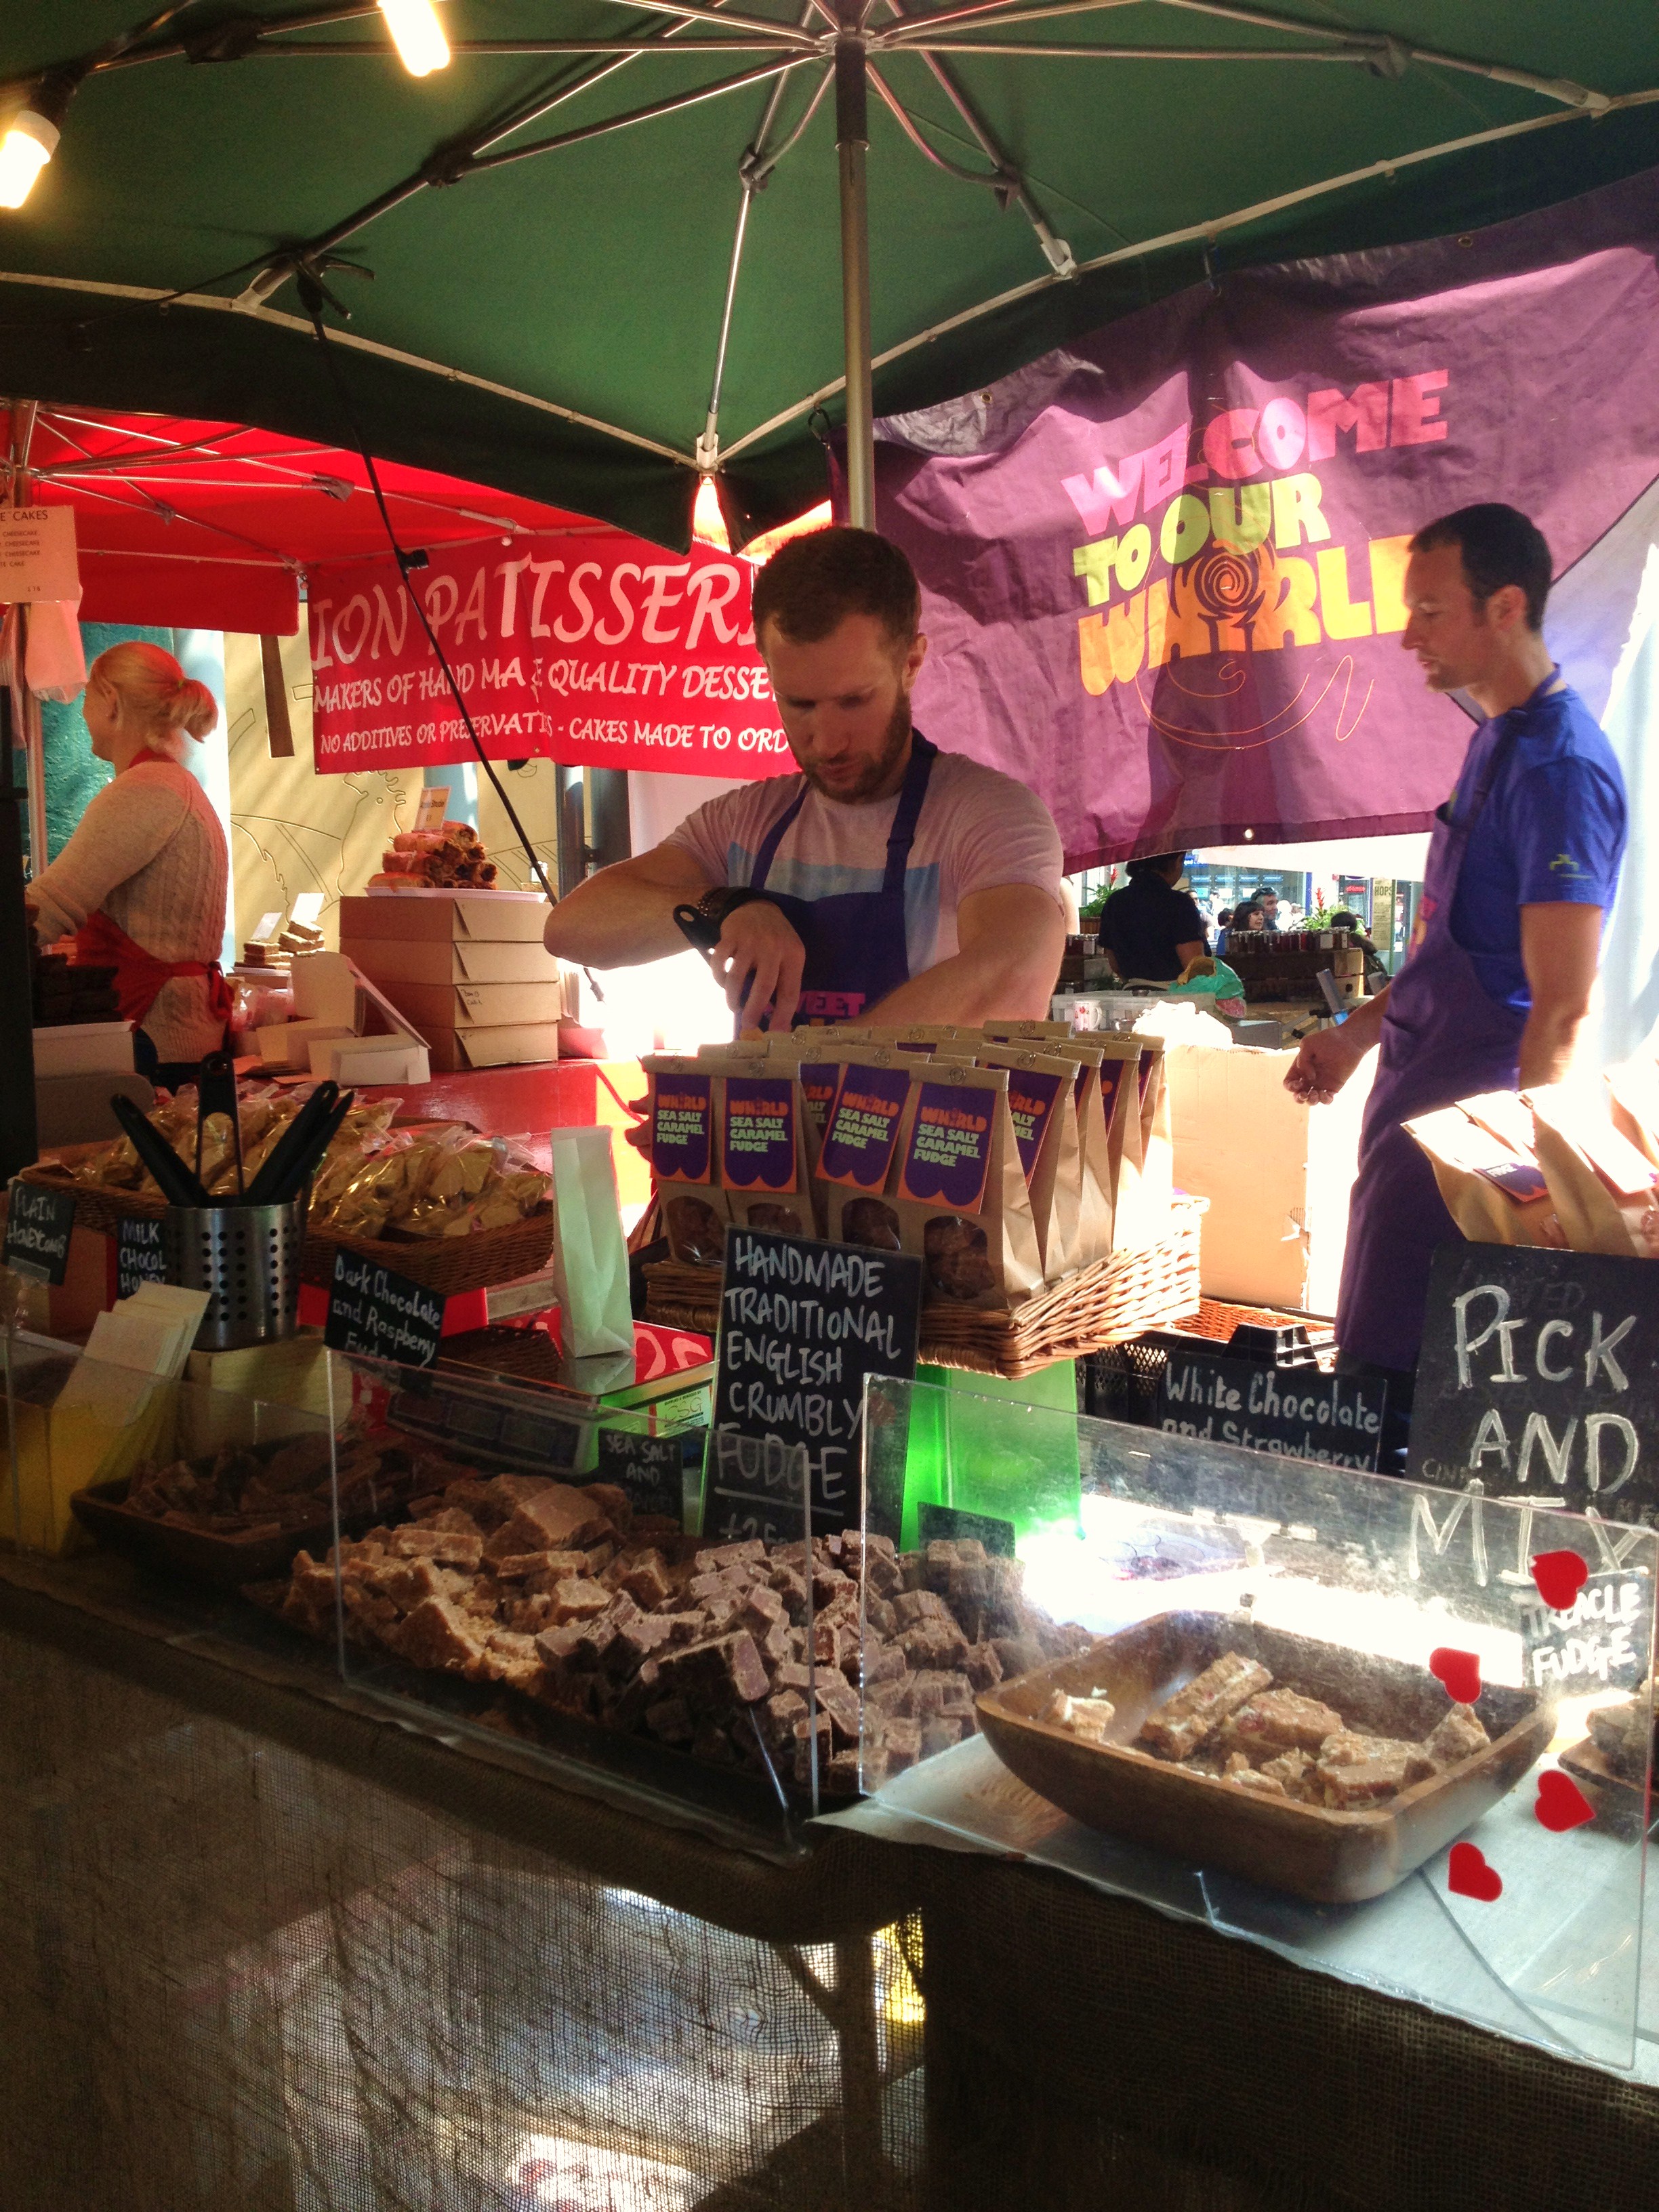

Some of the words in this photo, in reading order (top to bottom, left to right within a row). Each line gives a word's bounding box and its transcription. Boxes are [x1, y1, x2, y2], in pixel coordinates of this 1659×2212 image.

[1060, 369, 1449, 536] WELCOME
[13, 510, 49, 521] CAKES
[1073, 523, 1151, 607] TO
[1160, 472, 1332, 565] OUR
[312, 678, 382, 714] MAKERS
[387, 672, 415, 705] OF
[419, 662, 475, 701] HAND
[548, 659, 677, 697] QUALITY
[682, 665, 777, 701] DESSE
[321, 735, 341, 754] NO
[343, 725, 412, 752] ADDITIVES
[416, 722, 436, 745] OR
[569, 717, 628, 744] CAKES
[634, 720, 695, 747] MADE
[699, 724, 731, 749] TO
[657, 1110, 677, 1120] SEA
[678, 1111, 702, 1122] SALT
[657, 1122, 705, 1134] CARAMEL
[730, 1116, 754, 1128] SEA
[756, 1118, 784, 1129] SALT
[838, 1107, 861, 1123] SEA
[862, 1112, 890, 1129] SALT
[657, 1132, 689, 1145] FUDGE
[730, 1128, 788, 1141] CARAMEL
[832, 1131, 869, 1149] FUDGE
[835, 1120, 888, 1143] CARAMEL
[918, 1123, 945, 1139] SEA
[946, 1128, 980, 1145] SALT
[729, 1140, 769, 1152] FUDGE
[913, 1148, 958, 1167] FUDGE
[916, 1136, 981, 1159] CARAMEL
[16, 1186, 56, 1221] PLAIN
[123, 1221, 160, 1245] MILK
[735, 1235, 885, 1298] HANDMADE
[335, 1254, 371, 1295] Dark
[374, 1269, 441, 1330] Chocolate
[332, 1298, 363, 1325] and
[724, 1287, 901, 1359] TRADITIONAL
[1451, 1284, 1637, 1393] PICK
[726, 1330, 842, 1386] ENGLISH
[1166, 1361, 1242, 1412] White
[1248, 1370, 1380, 1435] Chocolate
[729, 1382, 864, 1440] CRUMBLY
[1162, 1416, 1212, 1441] and
[640, 1440, 676, 1464] SALT
[716, 1422, 847, 1500] FUDGE
[1469, 1408, 1641, 1494] AND
[626, 1462, 660, 1487] AND
[1532, 1625, 1637, 1687] FUDGE
